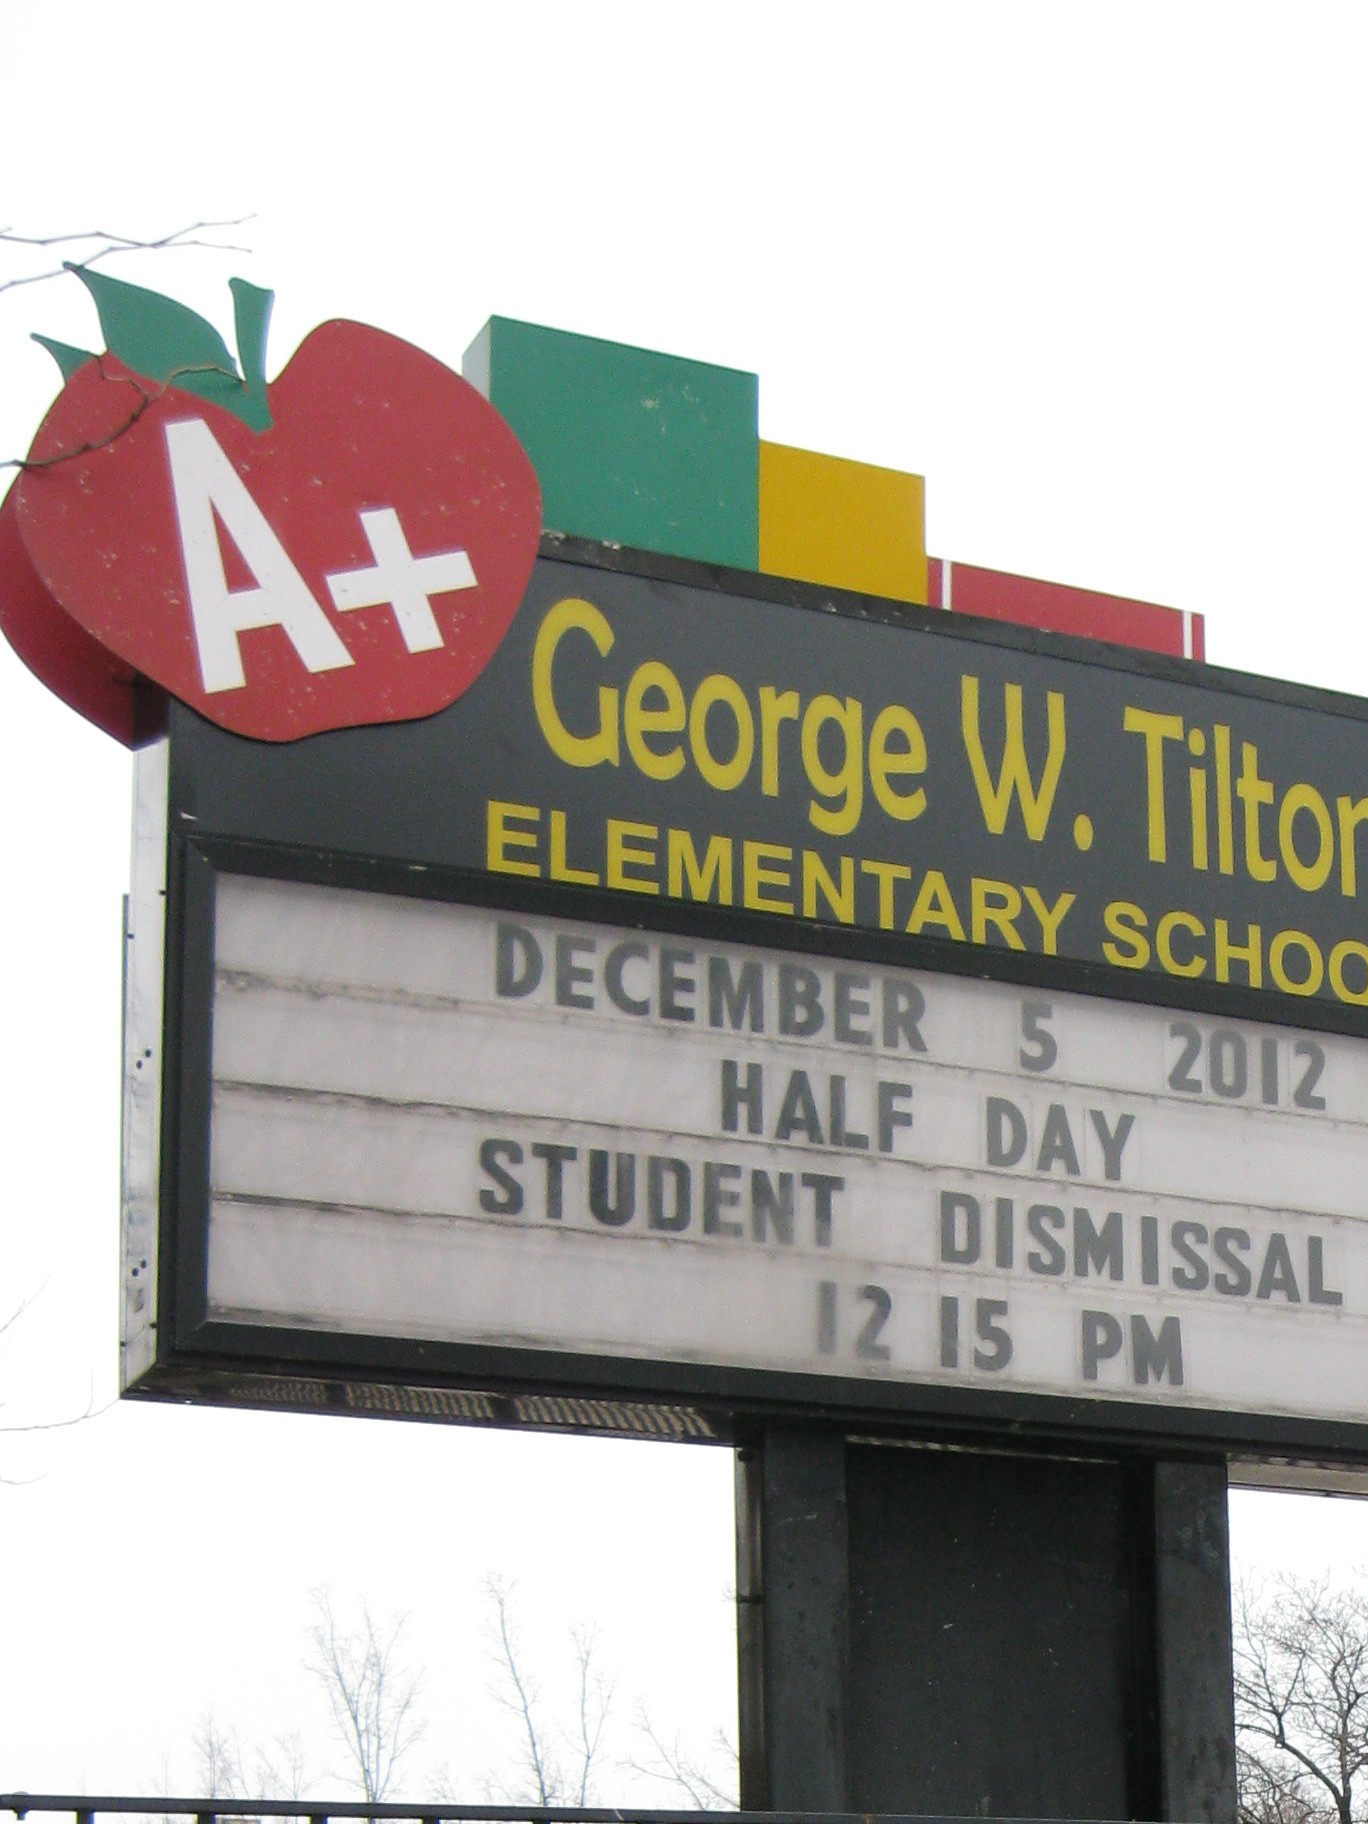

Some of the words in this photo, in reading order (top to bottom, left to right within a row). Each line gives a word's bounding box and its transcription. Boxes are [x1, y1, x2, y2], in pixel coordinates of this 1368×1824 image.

[165, 417, 477, 693] A+
[531, 597, 928, 837] George
[962, 675, 1095, 853] W.
[486, 800, 1076, 957] ELEMENTARY
[495, 921, 928, 1053] DECEMBER
[1019, 1002, 1059, 1073] 5
[1168, 1022, 1327, 1111] 2012
[720, 1059, 914, 1154] HALF
[985, 1096, 1136, 1181] DAY
[479, 1137, 846, 1248] STUDENT
[940, 1190, 1344, 1306] DISMISSAL
[816, 1280, 893, 1364] 12
[939, 1295, 1014, 1373] 15
[1081, 1309, 1185, 1387] PM
